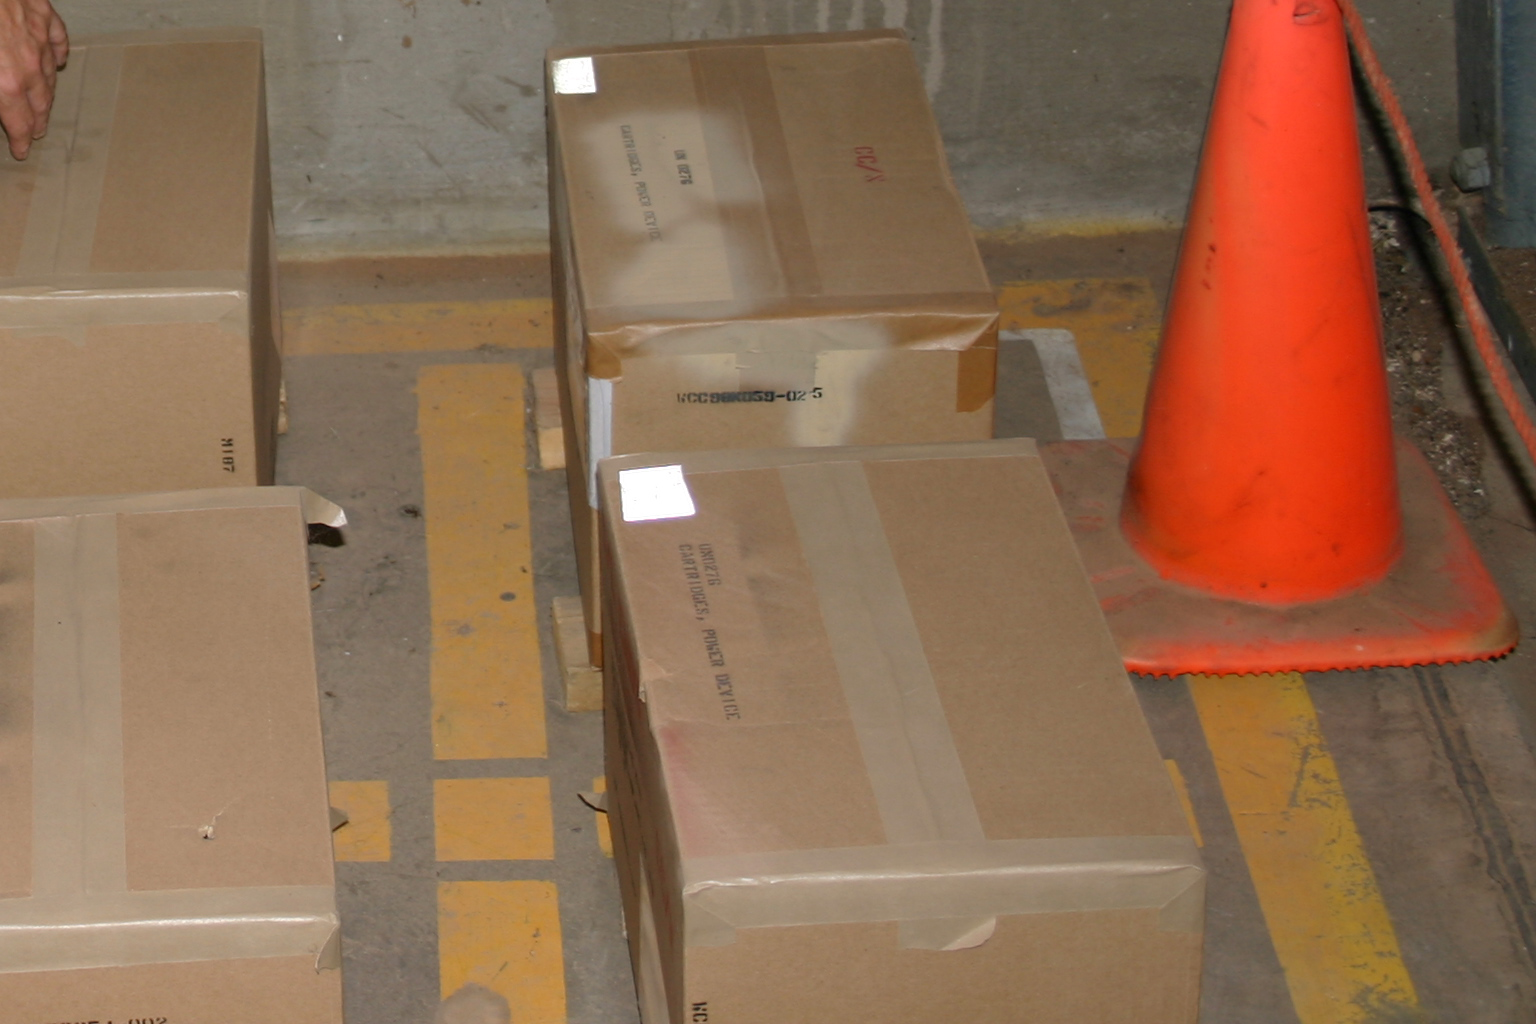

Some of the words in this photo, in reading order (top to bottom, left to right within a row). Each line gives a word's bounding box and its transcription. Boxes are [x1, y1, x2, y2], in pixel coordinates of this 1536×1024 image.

[677, 163, 695, 186] 0276
[634, 181, 652, 207] POWER
[699, 543, 722, 586] UN0276
[679, 543, 710, 622] CARTRIDGES,
[702, 629, 726, 668] POWER
[715, 673, 742, 721] DEVICE
